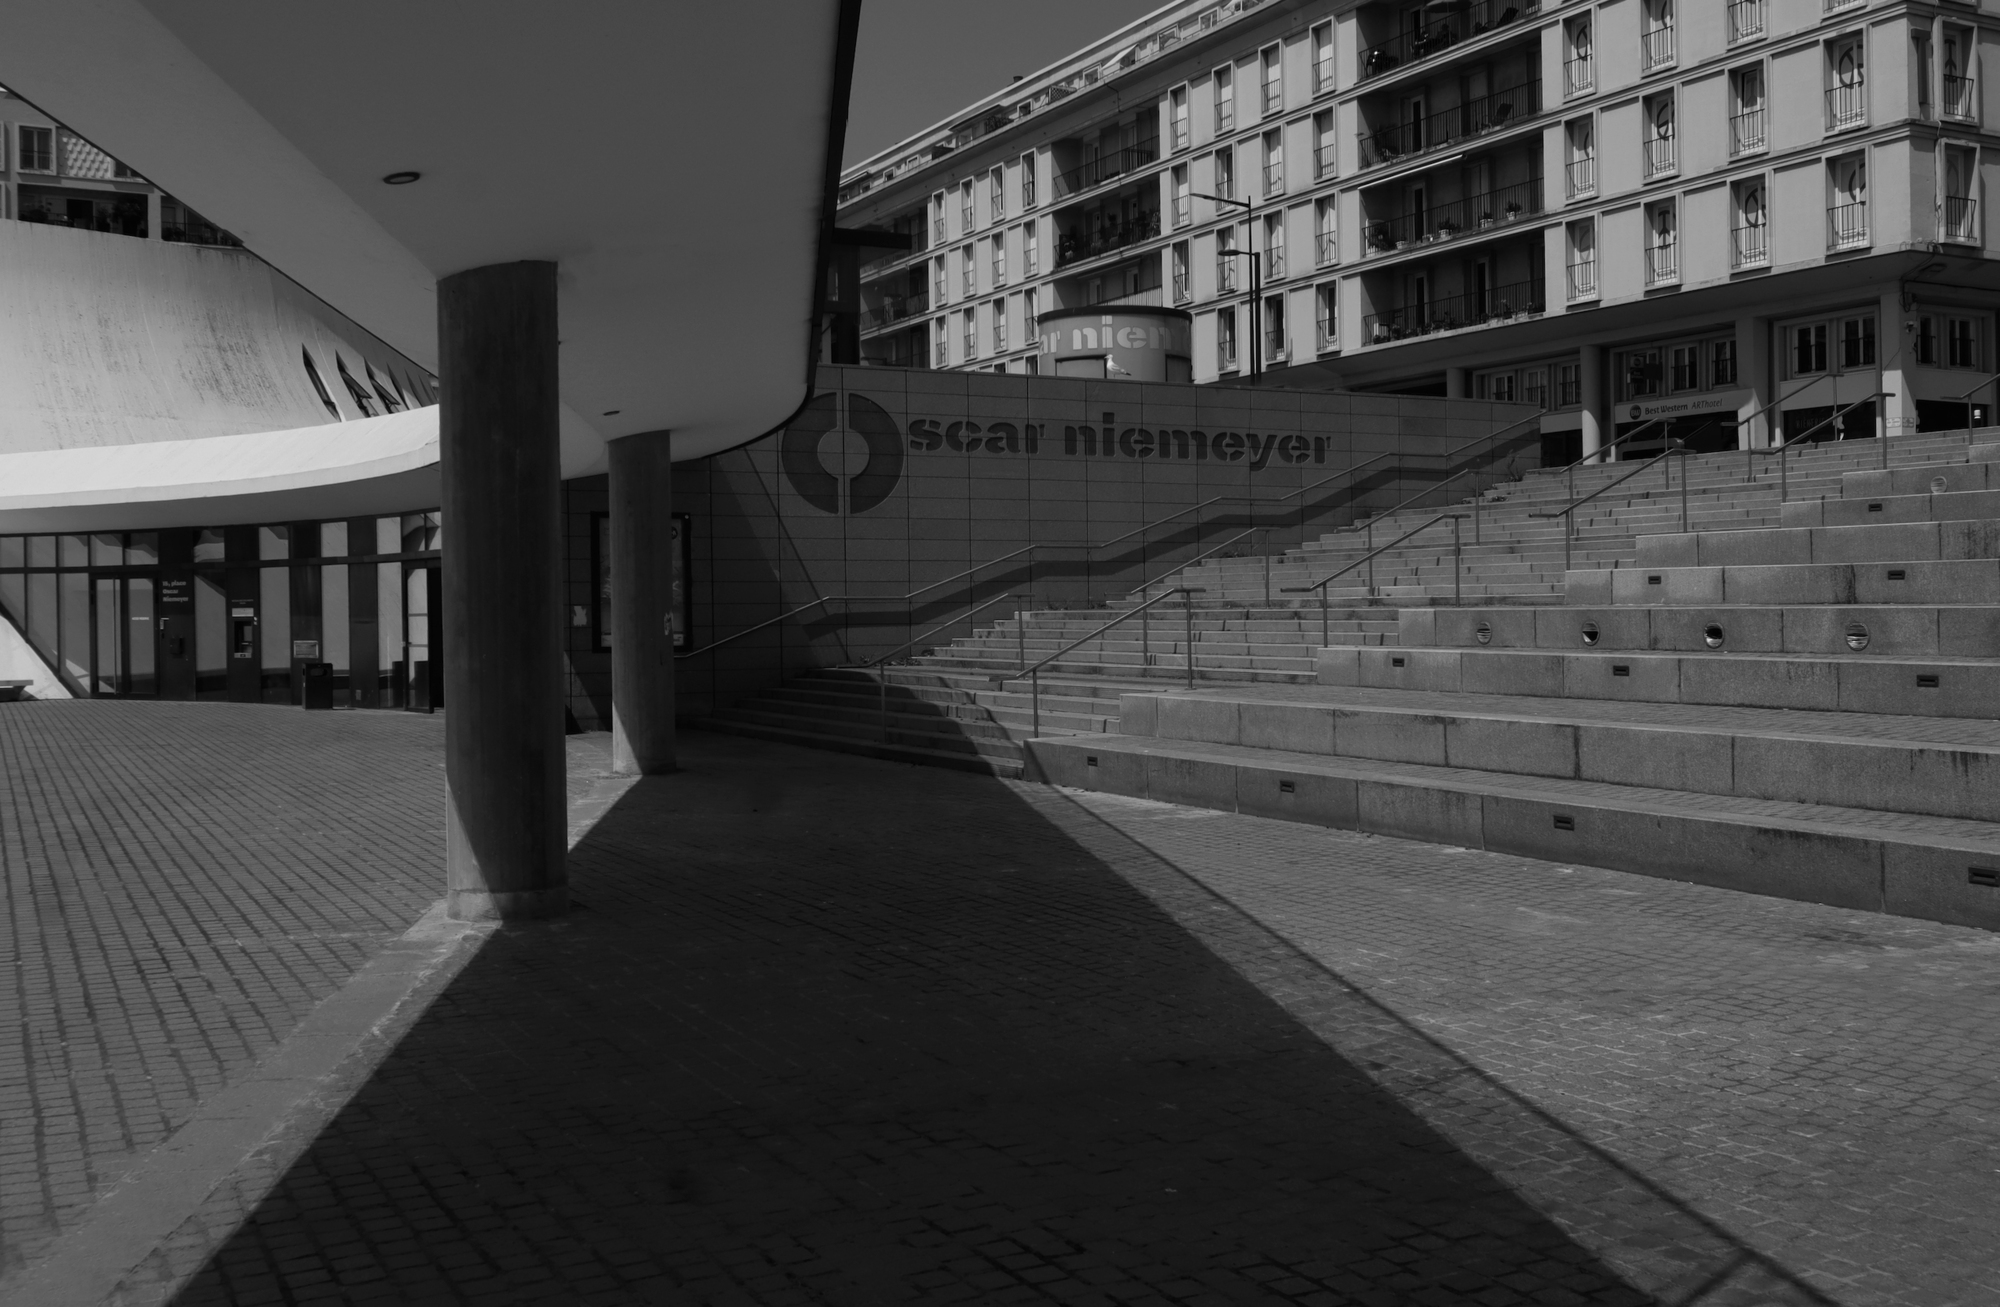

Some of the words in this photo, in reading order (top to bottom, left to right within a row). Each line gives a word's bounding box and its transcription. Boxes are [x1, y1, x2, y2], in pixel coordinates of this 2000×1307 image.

[1644, 406, 1660, 415] Best
[1660, 403, 1688, 413] Western
[1691, 398, 1723, 410] ARThotel
[1064, 411, 1331, 472] niemeyer
